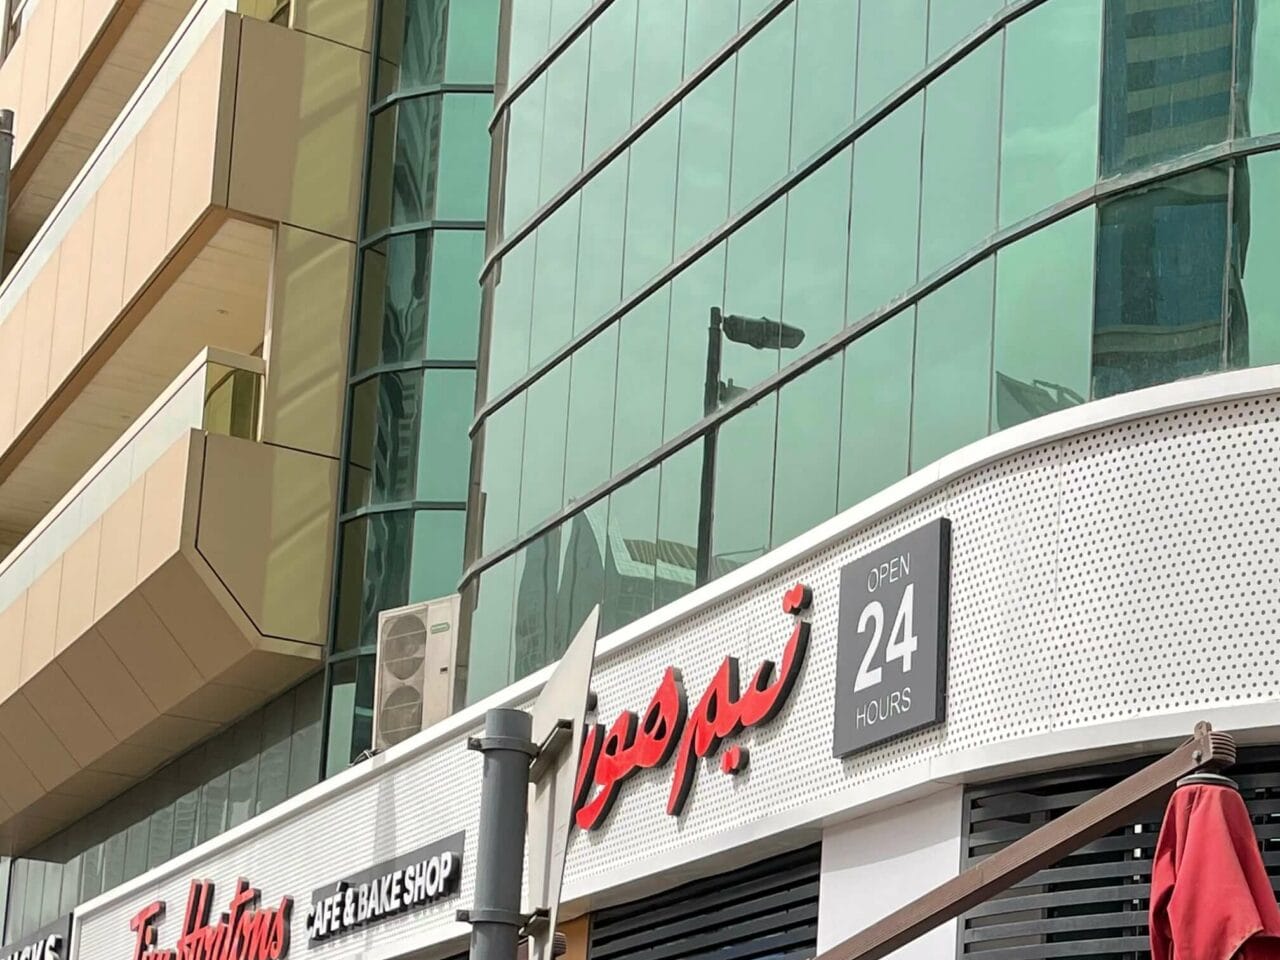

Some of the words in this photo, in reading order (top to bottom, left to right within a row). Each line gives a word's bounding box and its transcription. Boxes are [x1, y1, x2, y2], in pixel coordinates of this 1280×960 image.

[867, 552, 910, 593] OPEN
[854, 583, 918, 693] 24
[856, 687, 912, 729] HOURS
[306, 880, 343, 938] CAFÉ
[343, 887, 356, 927] &
[357, 869, 402, 922] BAKE
[403, 851, 453, 906] SHOP
